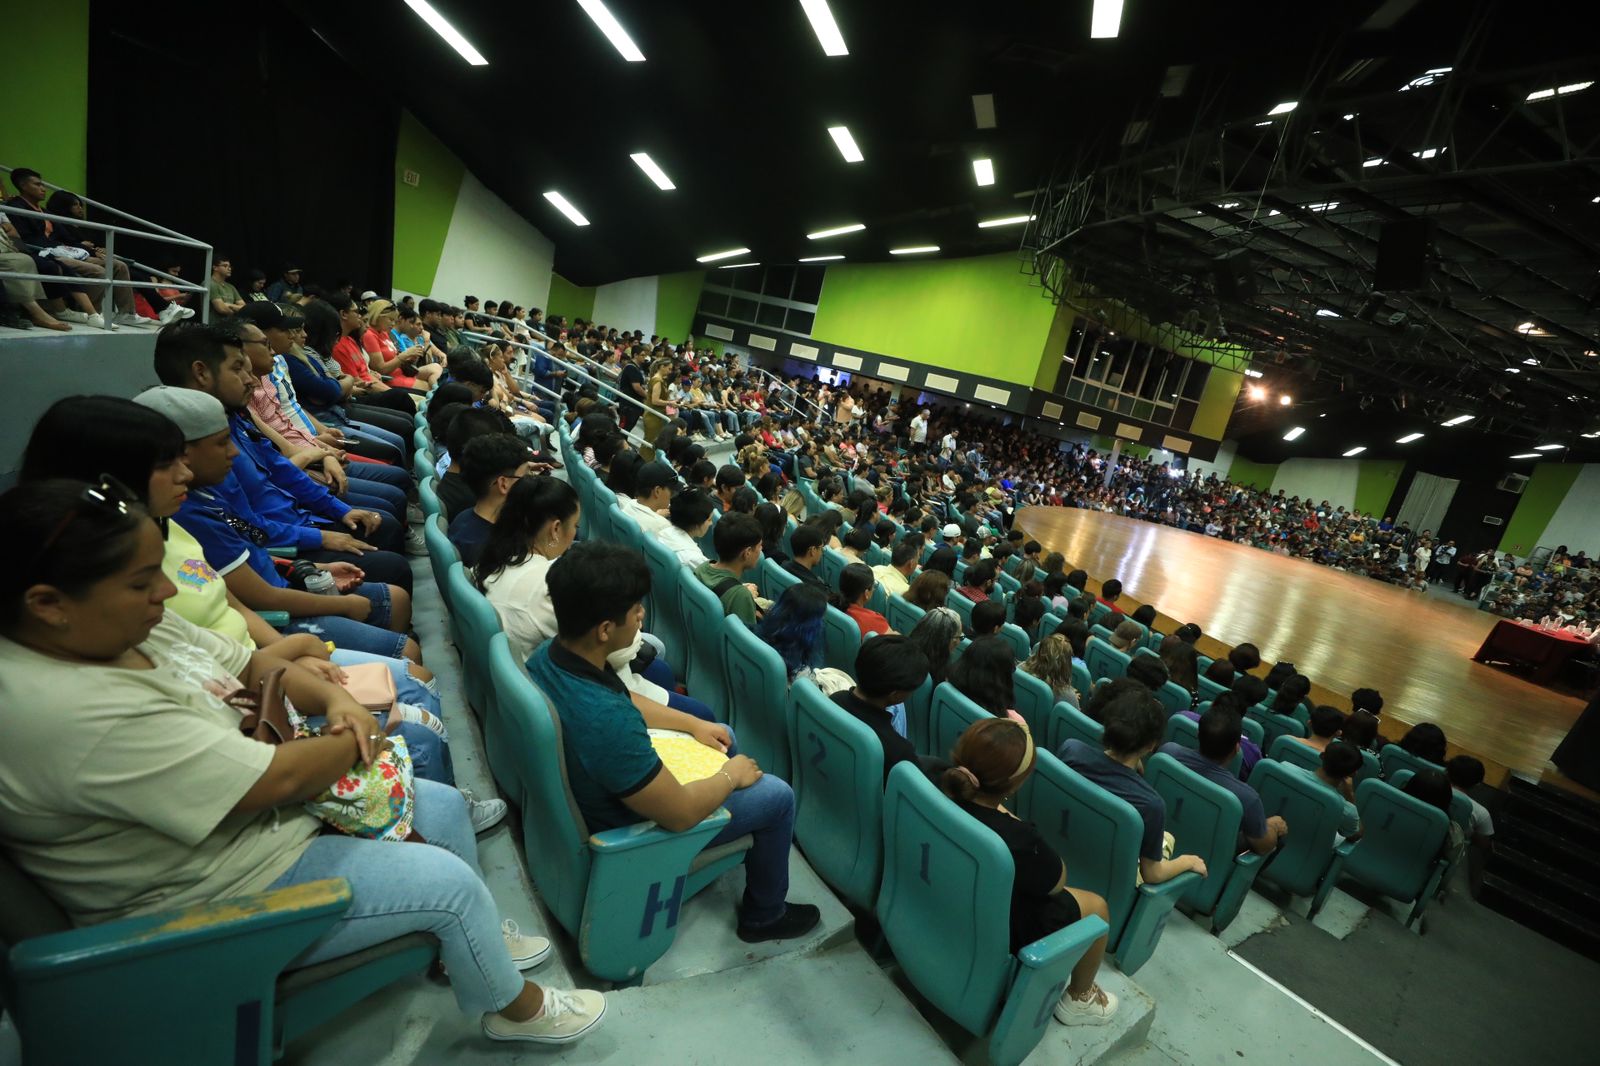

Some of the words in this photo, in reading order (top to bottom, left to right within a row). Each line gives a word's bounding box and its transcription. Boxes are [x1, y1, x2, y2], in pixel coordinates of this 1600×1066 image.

[808, 732, 829, 781] 2
[920, 842, 931, 887] 1
[639, 874, 687, 938] H
